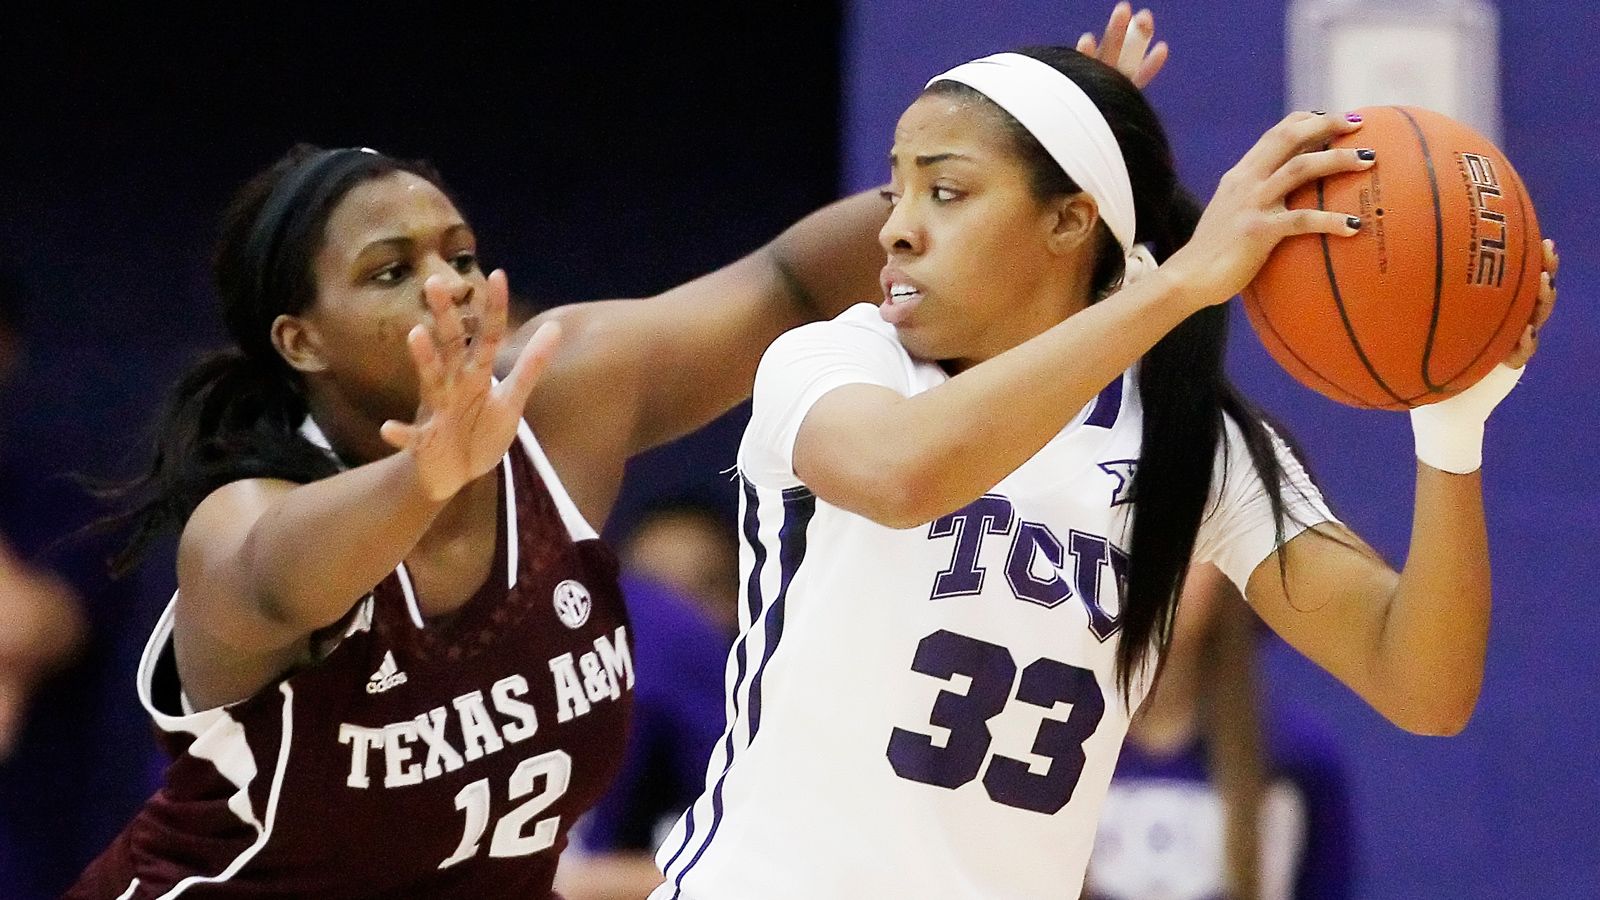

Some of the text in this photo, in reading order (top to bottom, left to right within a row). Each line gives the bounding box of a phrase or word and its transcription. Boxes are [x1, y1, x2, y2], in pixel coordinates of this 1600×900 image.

[1462, 152, 1507, 287] ELITE
[928, 494, 1131, 643] TCU
[338, 626, 635, 788] TEXAS A&M
[886, 629, 1105, 815] 33
[437, 749, 572, 869] 12
